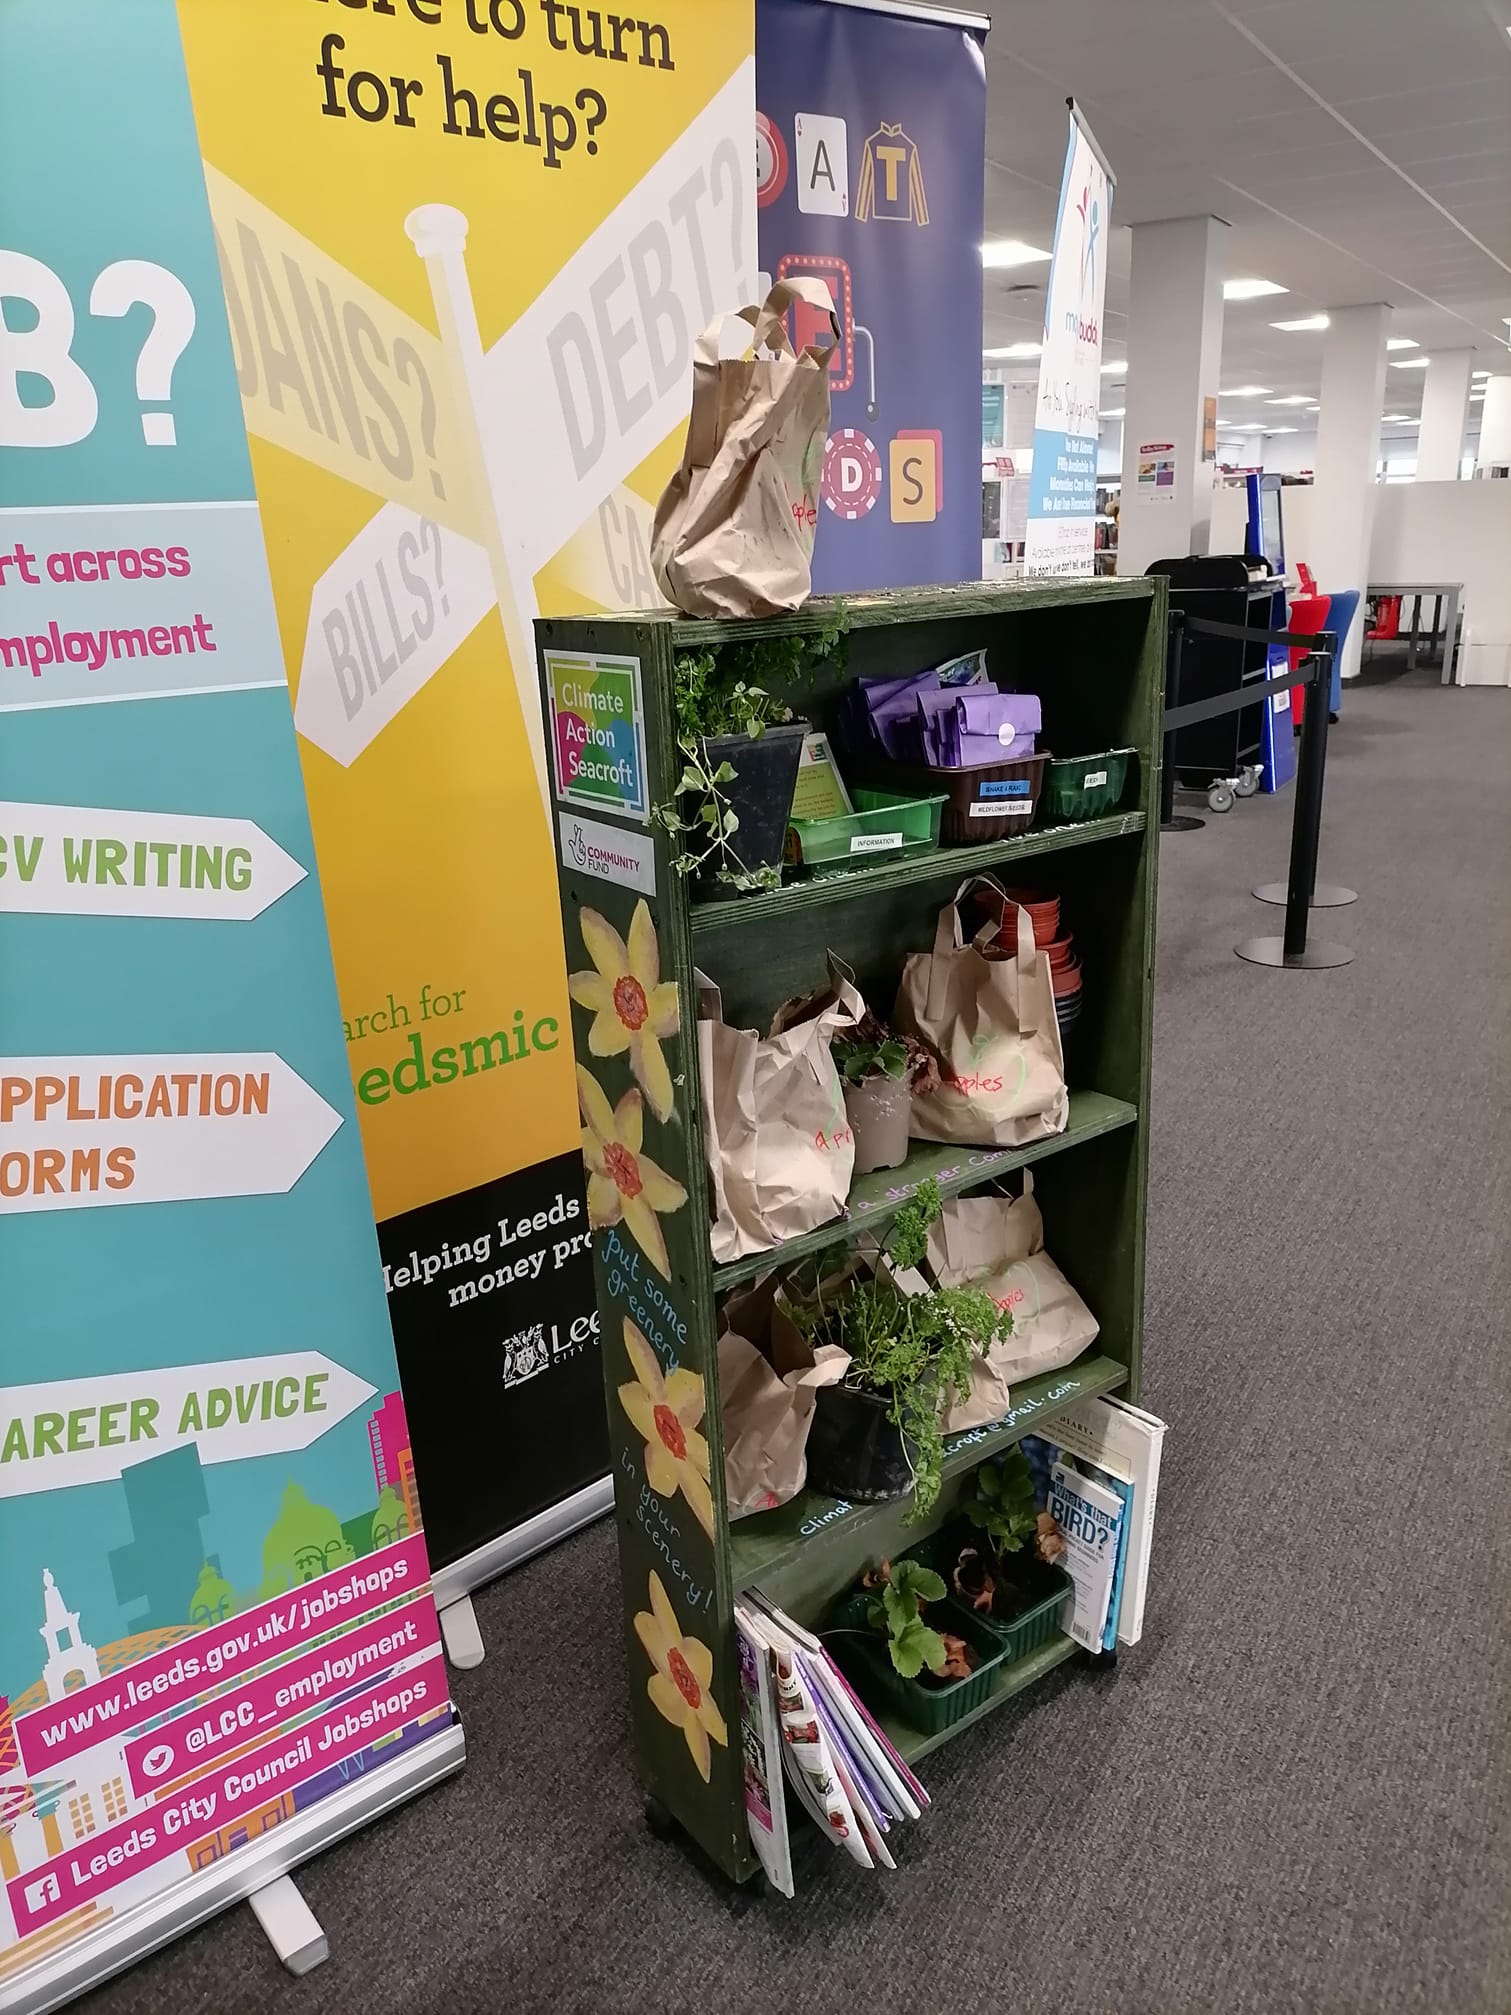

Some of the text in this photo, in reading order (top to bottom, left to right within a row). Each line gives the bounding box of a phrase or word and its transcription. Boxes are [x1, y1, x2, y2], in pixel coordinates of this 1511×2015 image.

[540, 0, 676, 71] turn
[316, 33, 607, 169] for help?
[546, 137, 750, 483] DEBT?
[46, 546, 191, 582] across
[598, 493, 660, 609] CA
[321, 514, 450, 722] BILLS?
[562, 682, 624, 714] Climate
[566, 718, 615, 749] Action
[568, 751, 633, 788] Seacroft
[0, 835, 253, 891] V WRITING
[587, 846, 641, 873] COMMUNITY
[588, 860, 610, 875] FUND
[857, 838, 896, 850] INFORMATION
[419, 984, 466, 1021] for
[498, 1194, 580, 1247] Leeds
[449, 1249, 546, 1308] money
[602, 1229, 688, 1345] put some
[608, 1268, 680, 1377] greenery
[554, 1343, 584, 1364] CITY
[0, 1372, 329, 1464] AREER ADVICE
[621, 1446, 636, 1479] in
[639, 1483, 681, 1538] your
[1050, 1498, 1109, 1550] BIRD?
[1053, 1482, 1113, 1528] What's that
[40, 1557, 409, 1749] www.leeds.gov.uk/jobshops
[184, 1620, 419, 1755] @LCC_employment
[71, 1827, 157, 1887] Leeds
[162, 1789, 218, 1837] City
[223, 1736, 312, 1803] Council
[318, 1678, 429, 1754] Jobshops
